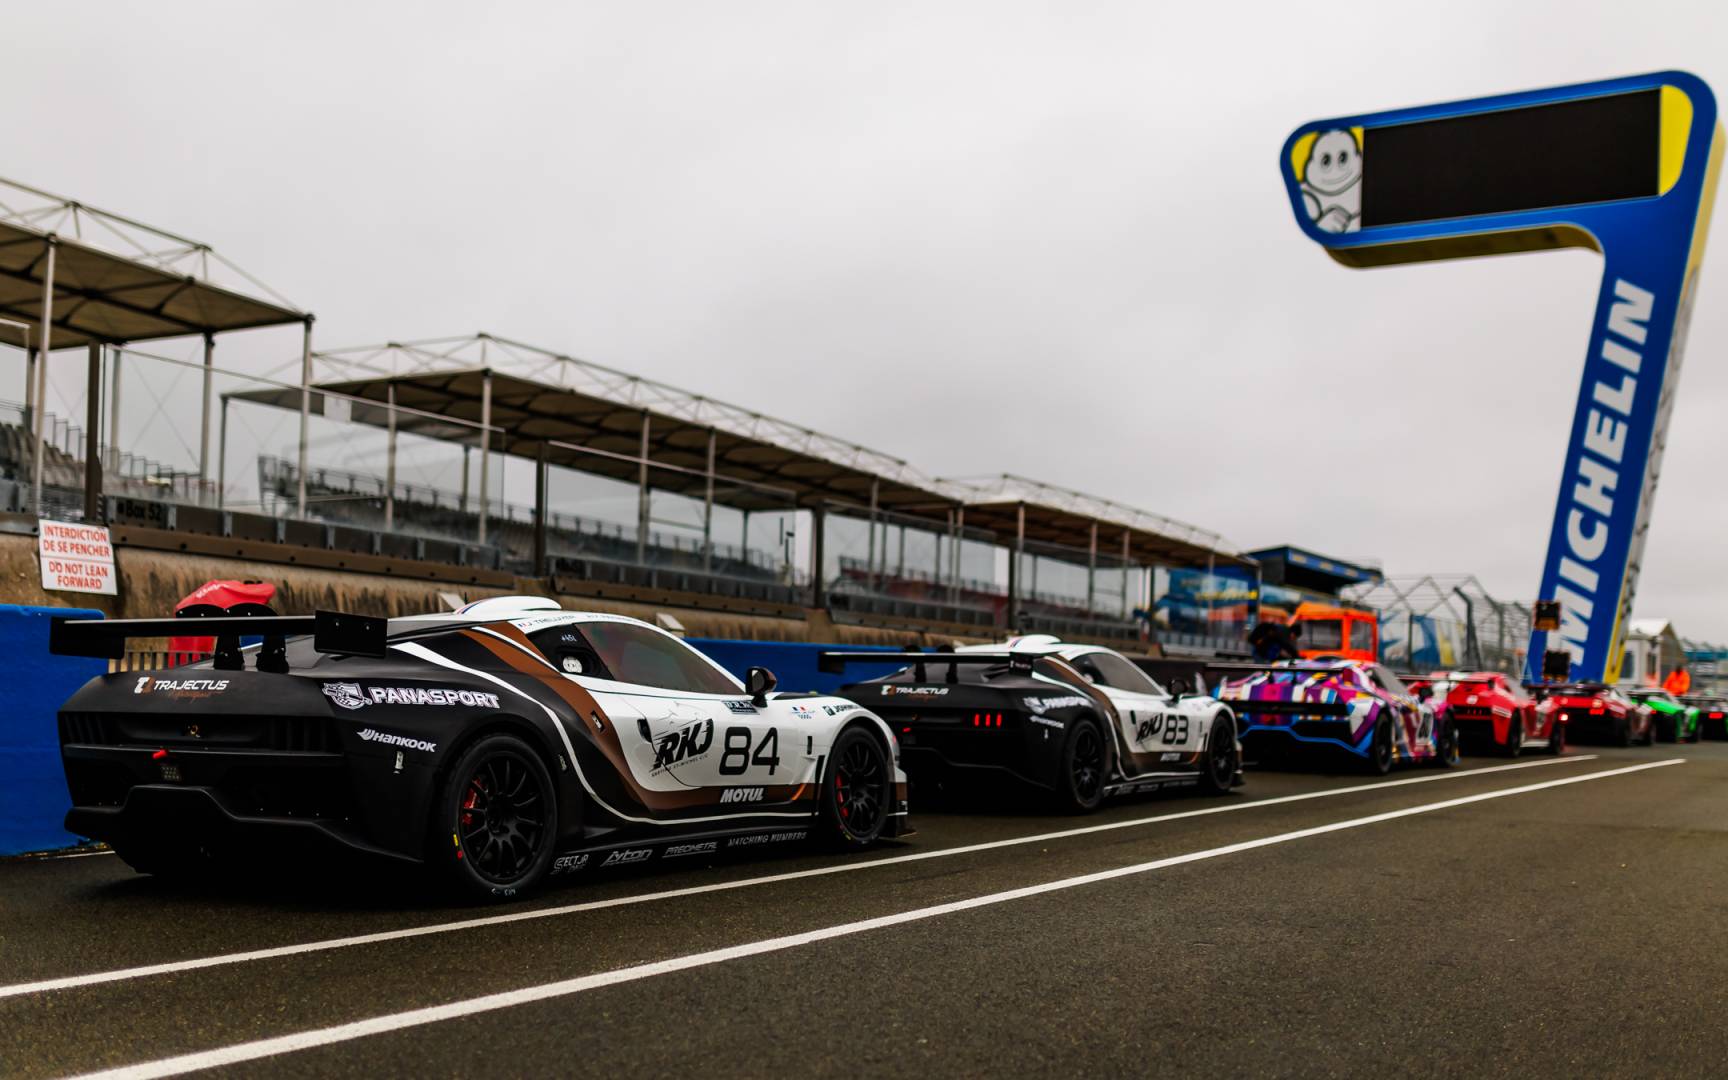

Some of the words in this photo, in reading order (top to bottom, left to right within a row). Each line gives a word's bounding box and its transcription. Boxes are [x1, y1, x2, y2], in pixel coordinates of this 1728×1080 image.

[1544, 277, 1655, 667] MICHELIN
[44, 525, 107, 542] INTERDICTION
[43, 541, 55, 552] DE
[58, 542, 67, 553] SE
[70, 543, 110, 558] PENCHER
[49, 561, 62, 573] DO
[65, 563, 83, 575] NOT
[85, 566, 108, 577] LEAN
[57, 576, 102, 589] FORWARD
[154, 680, 229, 691] TRAJECTUS
[896, 688, 949, 696] TRAJECTUS
[368, 687, 501, 709] PANASPORT
[1163, 715, 1189, 745] 83
[719, 727, 780, 776] 84
[720, 788, 764, 803] MOTUL
